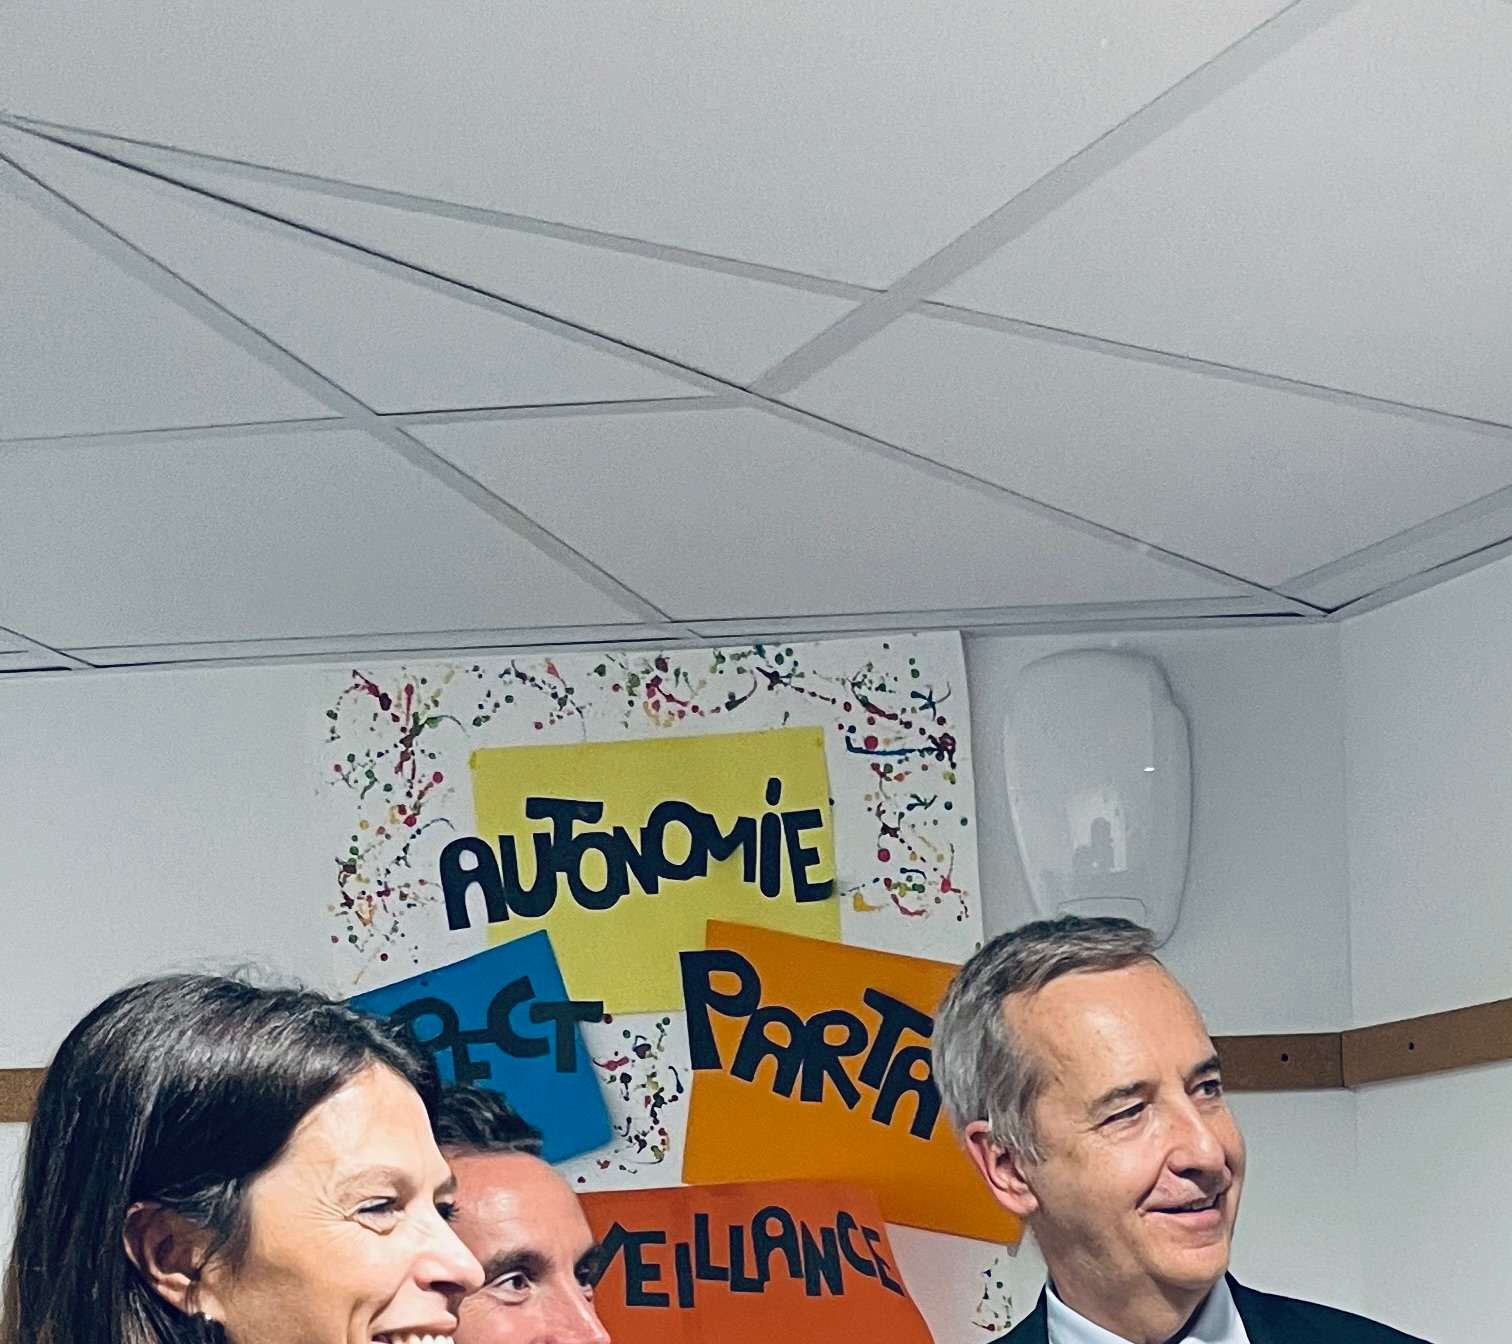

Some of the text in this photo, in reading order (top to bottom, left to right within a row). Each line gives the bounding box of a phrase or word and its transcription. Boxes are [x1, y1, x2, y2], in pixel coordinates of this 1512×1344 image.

[388, 975, 604, 1085] PECT
[679, 949, 943, 1140] PARTA
[590, 1205, 905, 1308] EILLANCE
